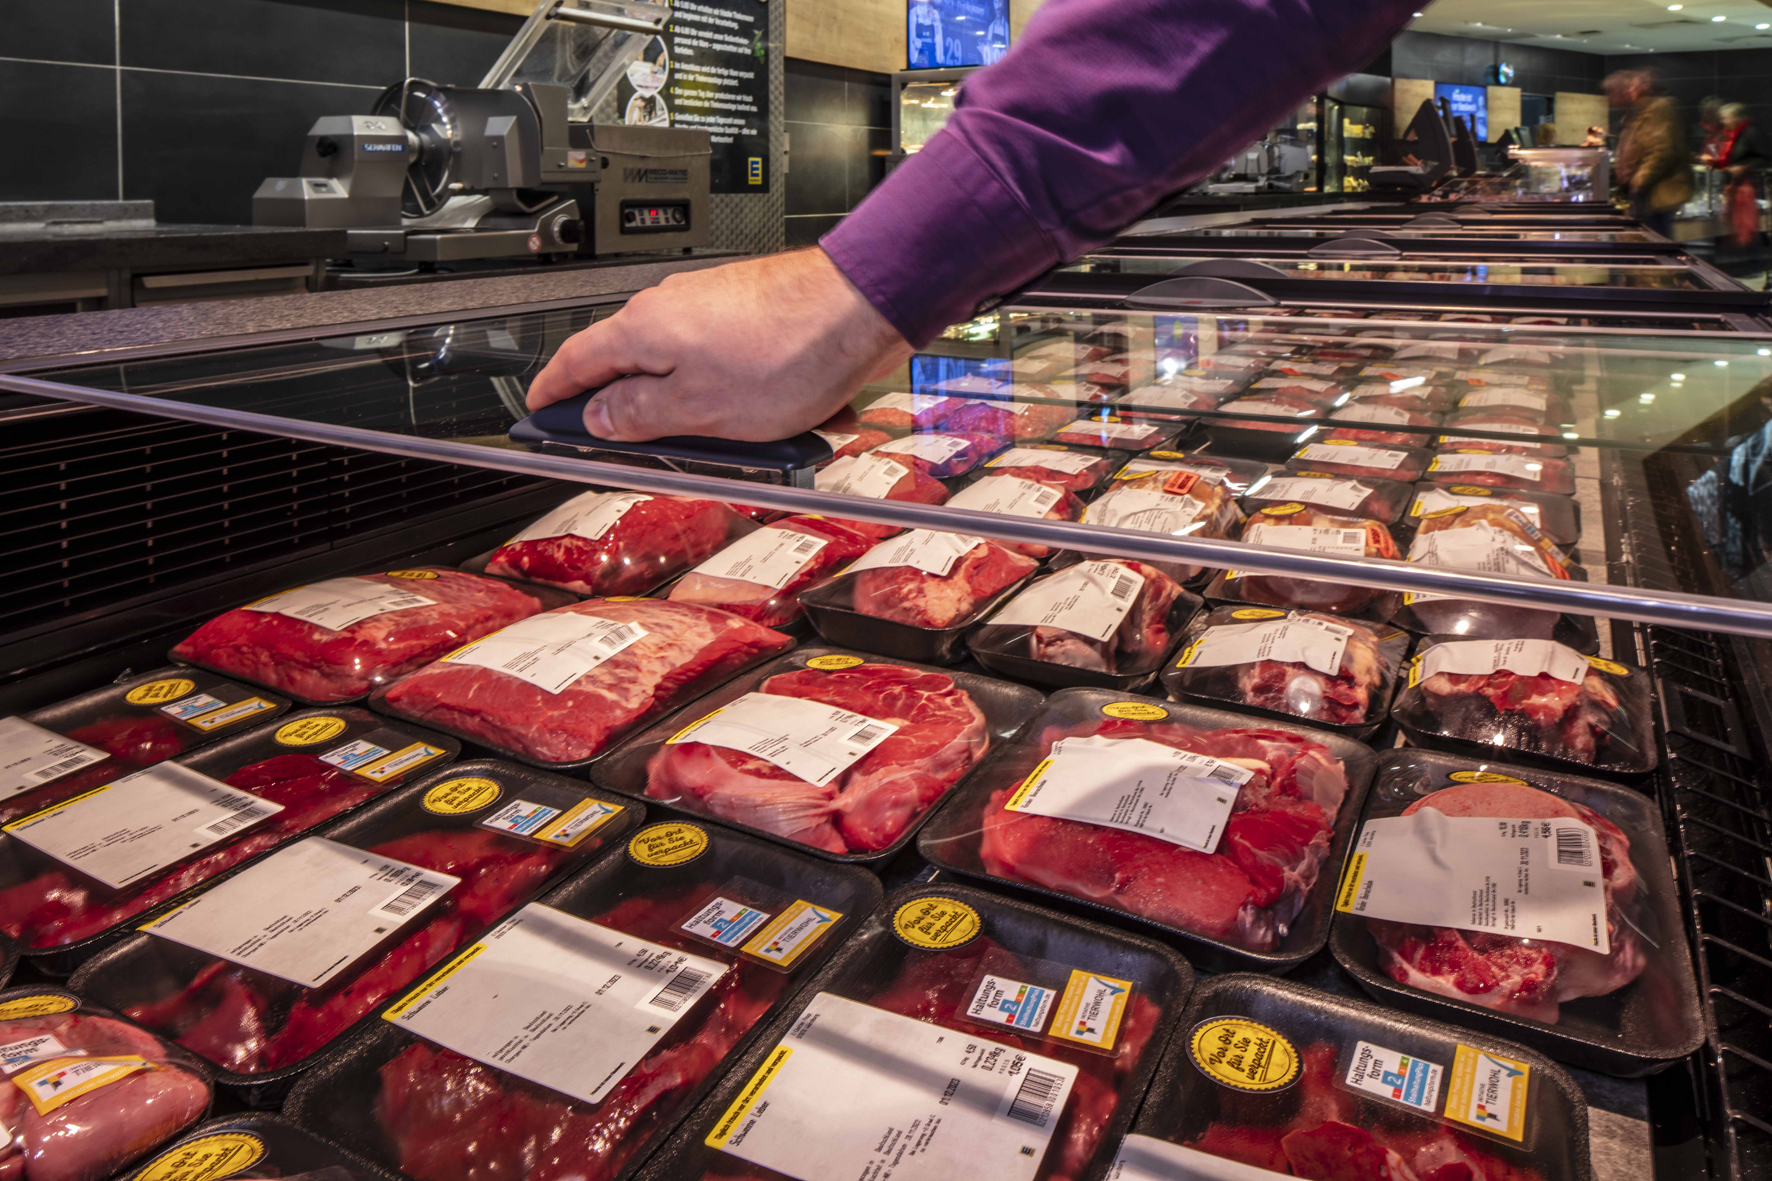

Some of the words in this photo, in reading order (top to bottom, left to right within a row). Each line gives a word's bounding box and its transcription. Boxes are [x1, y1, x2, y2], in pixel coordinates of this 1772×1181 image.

[428, 791, 454, 804] Vor
[446, 782, 468, 792] Ort
[442, 795, 463, 805] für
[455, 786, 474, 795] Sie
[636, 834, 663, 845] Vor
[660, 827, 685, 838] Ort
[642, 840, 667, 851] für
[663, 834, 686, 844] Sie
[643, 839, 697, 858] verpackt.
[685, 898, 726, 930] Haltungs-
[702, 908, 725, 925] form
[715, 920, 729, 928] 2
[900, 915, 926, 930] Vor
[916, 902, 939, 915] Ort
[915, 920, 941, 934] für
[928, 909, 949, 921] Sie
[928, 911, 965, 940] verpackt.
[781, 915, 816, 943] TIERWOHL
[971, 977, 1000, 1015] Haltungs-
[986, 989, 1004, 1009] form
[1086, 987, 1106, 1021] TIERWOHL
[1217, 1026, 1235, 1045] Ort
[1233, 1035, 1250, 1052] Sie
[1006, 1053, 1027, 1077] 1,05€
[1207, 1044, 1228, 1066] Vor
[1226, 1052, 1248, 1071] für
[1243, 1035, 1271, 1081] verpackt.
[1350, 1044, 1374, 1086] Haltungs-
[1366, 1057, 1383, 1080] form
[1387, 1075, 1401, 1085] 2
[1406, 1061, 1426, 1103] StallhaltungPlus
[1422, 1068, 1439, 1106] haltungsform.de
[1484, 1067, 1500, 1106] TIERWOHL
[725, 1110, 740, 1124] frisch
[741, 1095, 751, 1104] Ort
[728, 1117, 756, 1146] Schweine
[749, 1100, 770, 1118] Leber
[165, 1148, 202, 1168] Ort
[186, 1152, 216, 1168] Sie
